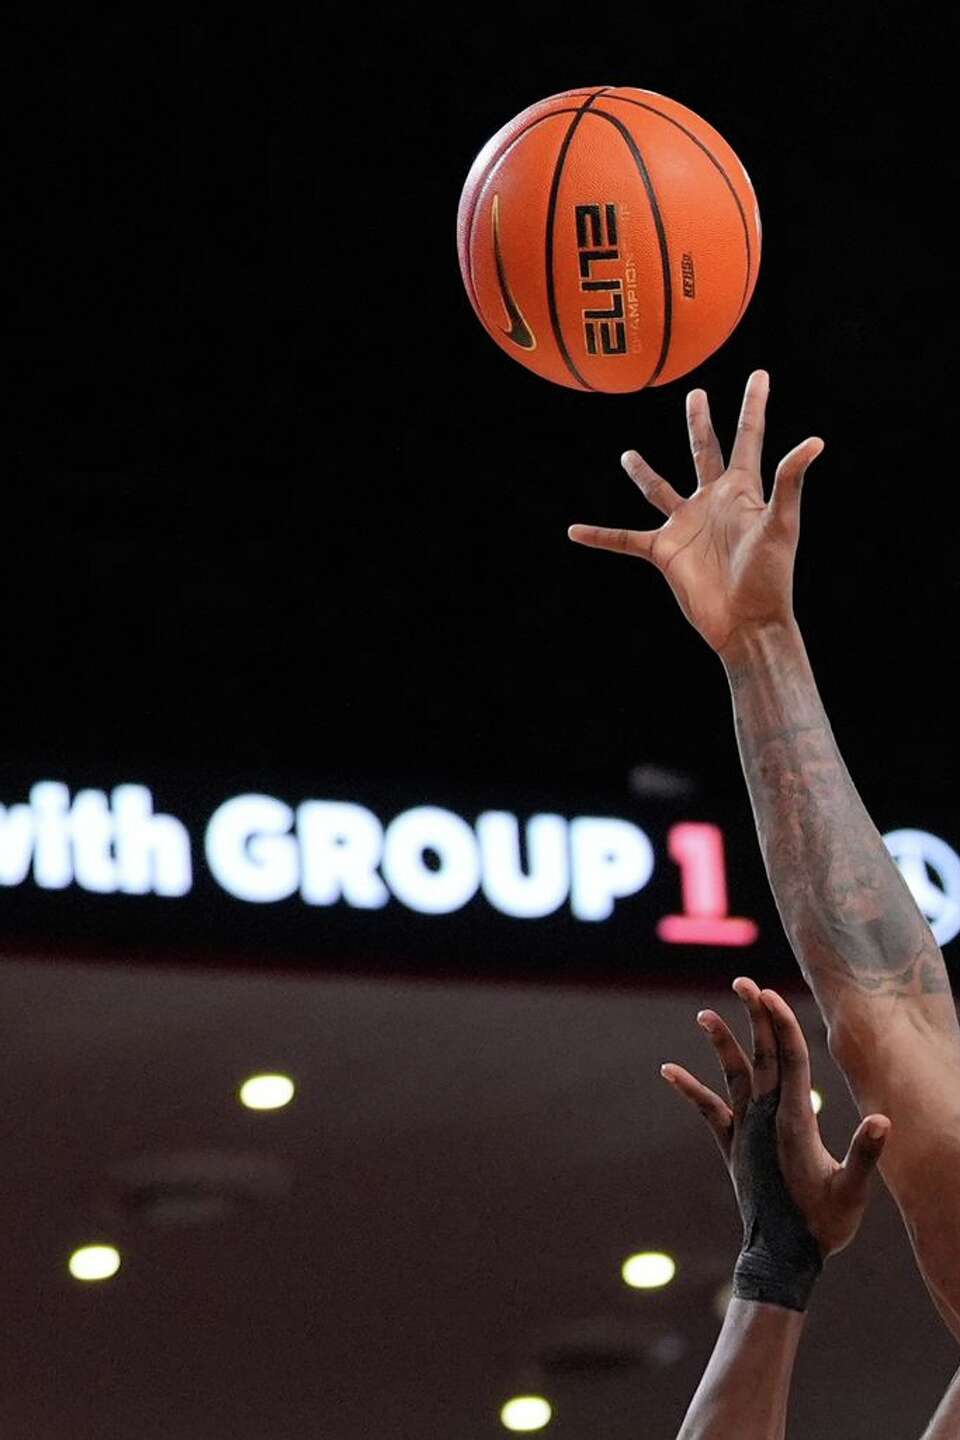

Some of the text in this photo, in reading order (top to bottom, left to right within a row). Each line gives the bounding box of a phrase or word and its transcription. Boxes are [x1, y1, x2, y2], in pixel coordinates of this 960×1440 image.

[575, 202, 629, 357] ELITE
[205, 793, 652, 921] GROUP
[656, 822, 758, 946] 1
